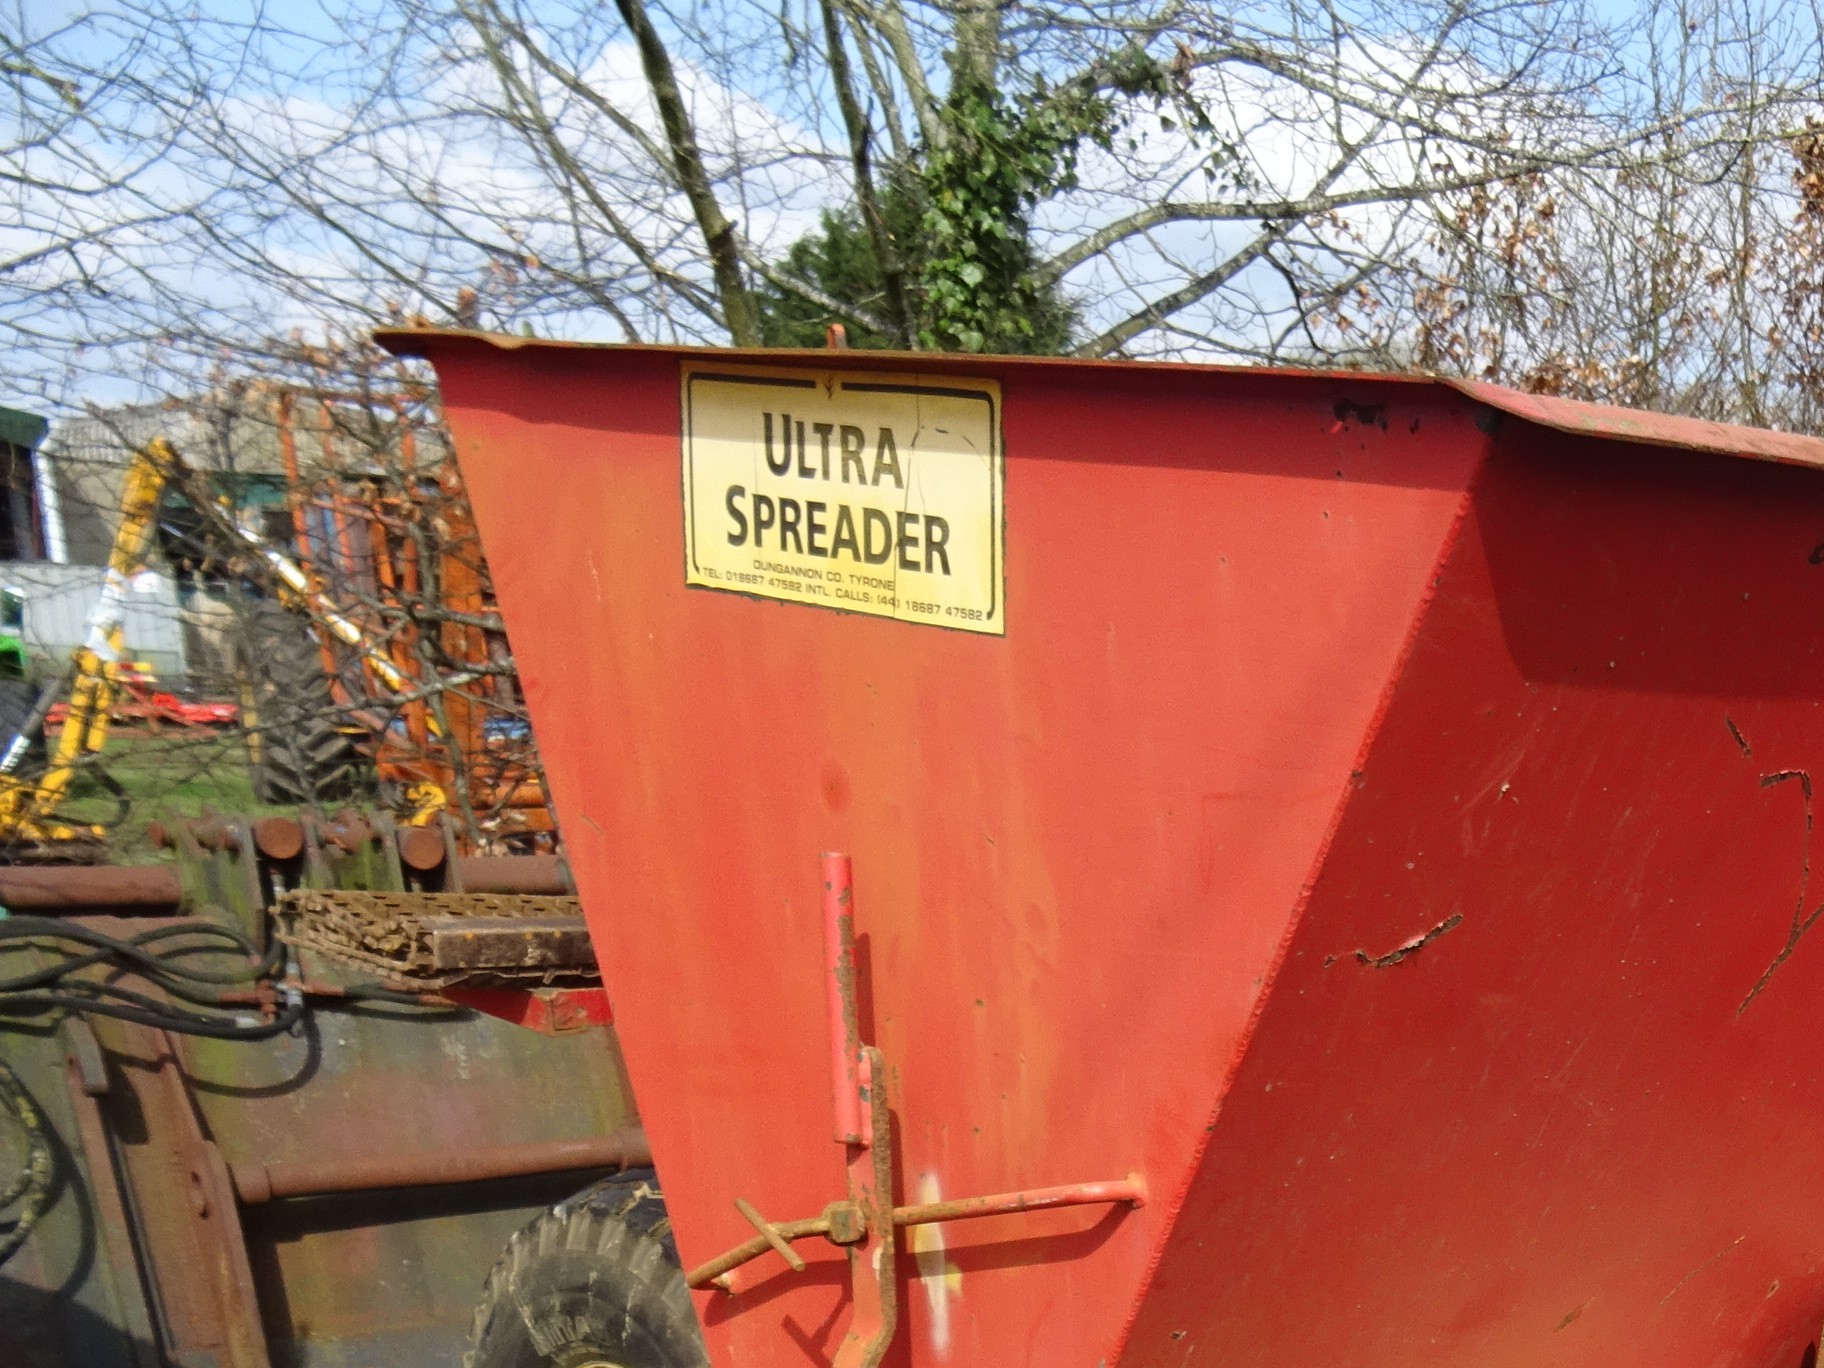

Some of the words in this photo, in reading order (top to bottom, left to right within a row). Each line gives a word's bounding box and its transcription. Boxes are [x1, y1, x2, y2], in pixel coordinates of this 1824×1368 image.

[762, 411, 905, 490] ULTRA
[724, 484, 952, 576] SPREADER
[702, 567, 723, 580] TEL:
[768, 577, 802, 593] 47582
[835, 588, 873, 603] CALLS:
[877, 594, 901, 609] (44)
[905, 600, 941, 615] 18687
[945, 606, 983, 621] 47582
[753, 559, 823, 580] DUNGANNON
[826, 571, 844, 584] CO.
[849, 574, 895, 591] TYRONE
